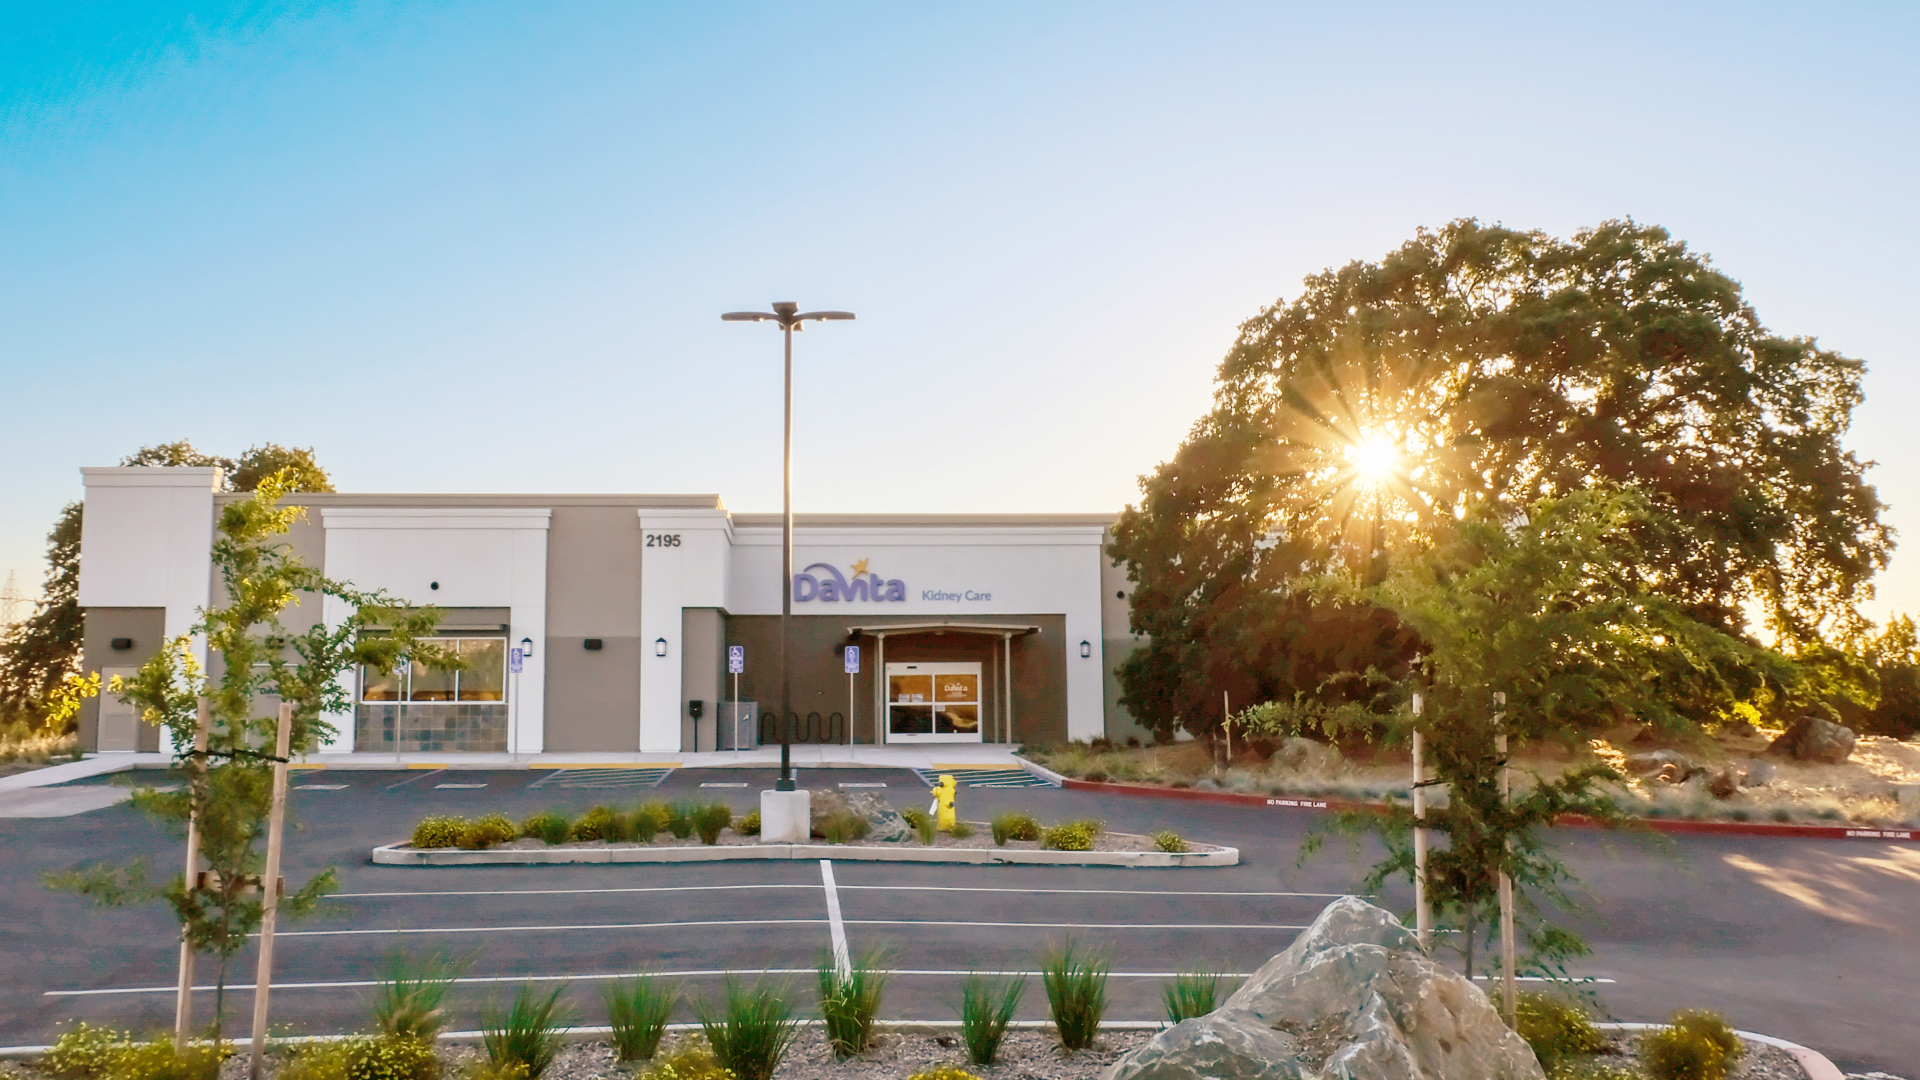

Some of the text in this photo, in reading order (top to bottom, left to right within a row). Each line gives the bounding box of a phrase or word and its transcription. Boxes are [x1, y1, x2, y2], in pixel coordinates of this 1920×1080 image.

[646, 534, 681, 547] 2195
[793, 560, 906, 602] DaVita
[922, 590, 992, 603] Kidney Care
